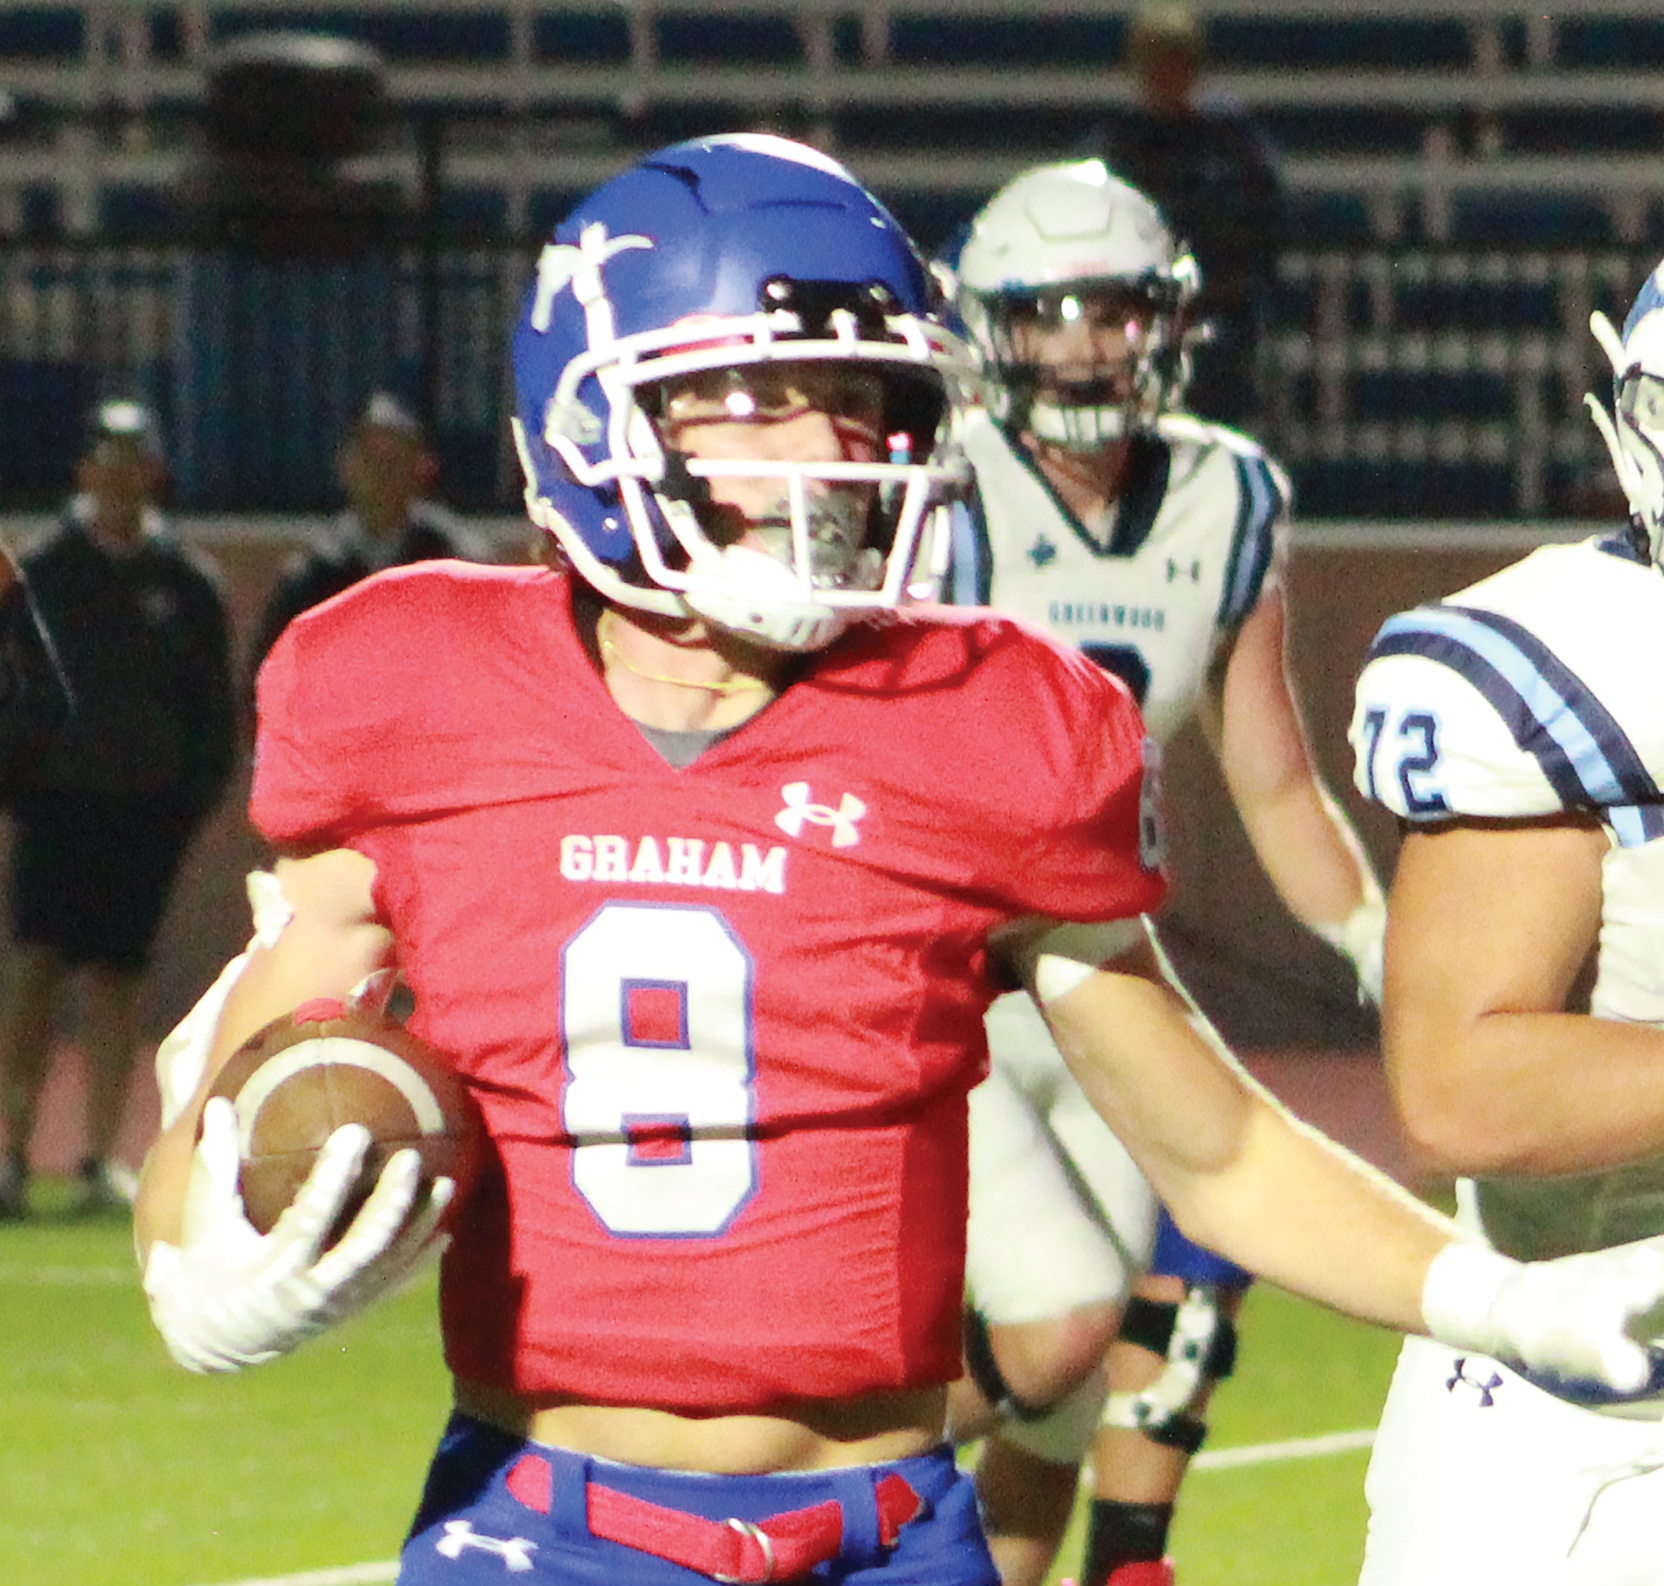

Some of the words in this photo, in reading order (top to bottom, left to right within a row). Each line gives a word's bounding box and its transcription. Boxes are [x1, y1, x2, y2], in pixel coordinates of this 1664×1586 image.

[1362, 704, 1451, 818] 72
[559, 834, 788, 893] GRAHAM
[558, 899, 760, 1240] 8
